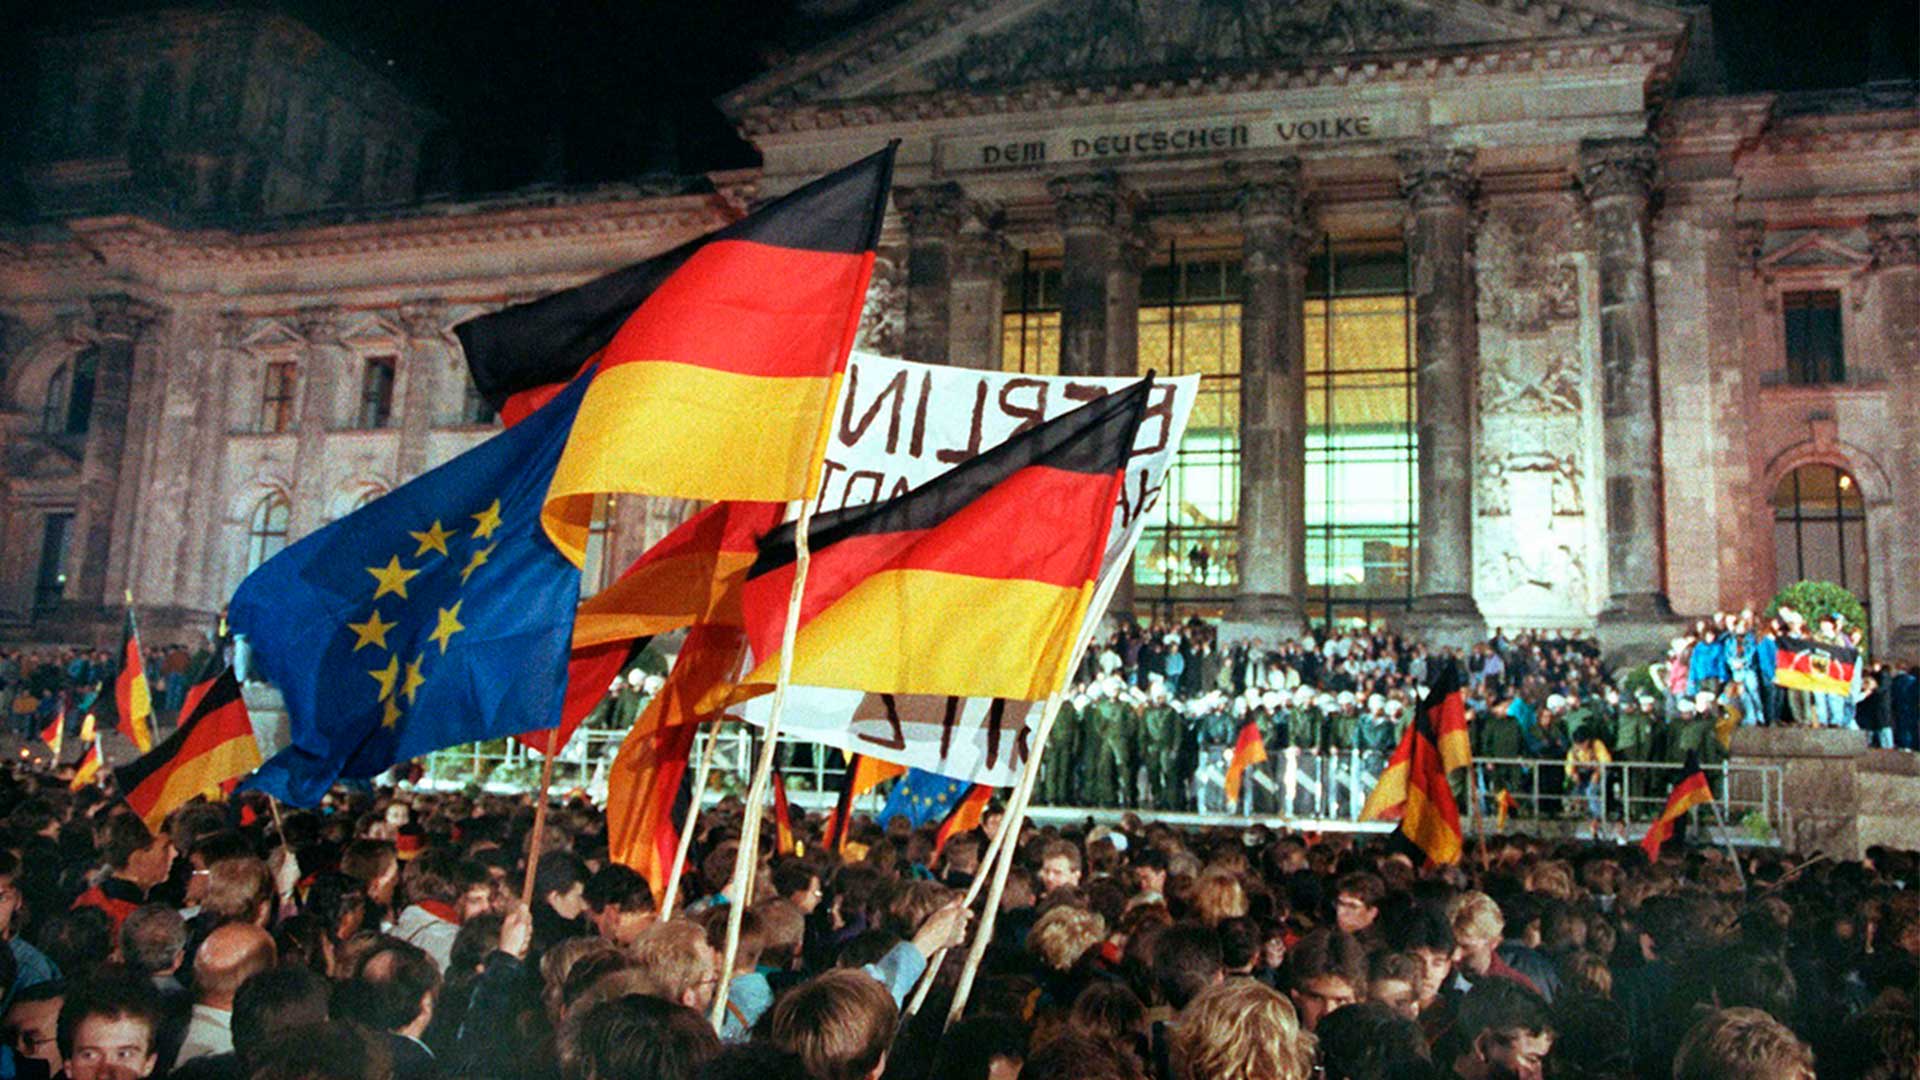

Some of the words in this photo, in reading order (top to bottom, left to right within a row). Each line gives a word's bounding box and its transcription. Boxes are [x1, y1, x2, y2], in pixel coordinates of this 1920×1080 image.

[983, 140, 1046, 164] DEM
[1073, 124, 1248, 158] DEUTSCHEN
[1276, 116, 1371, 141] VOLKE
